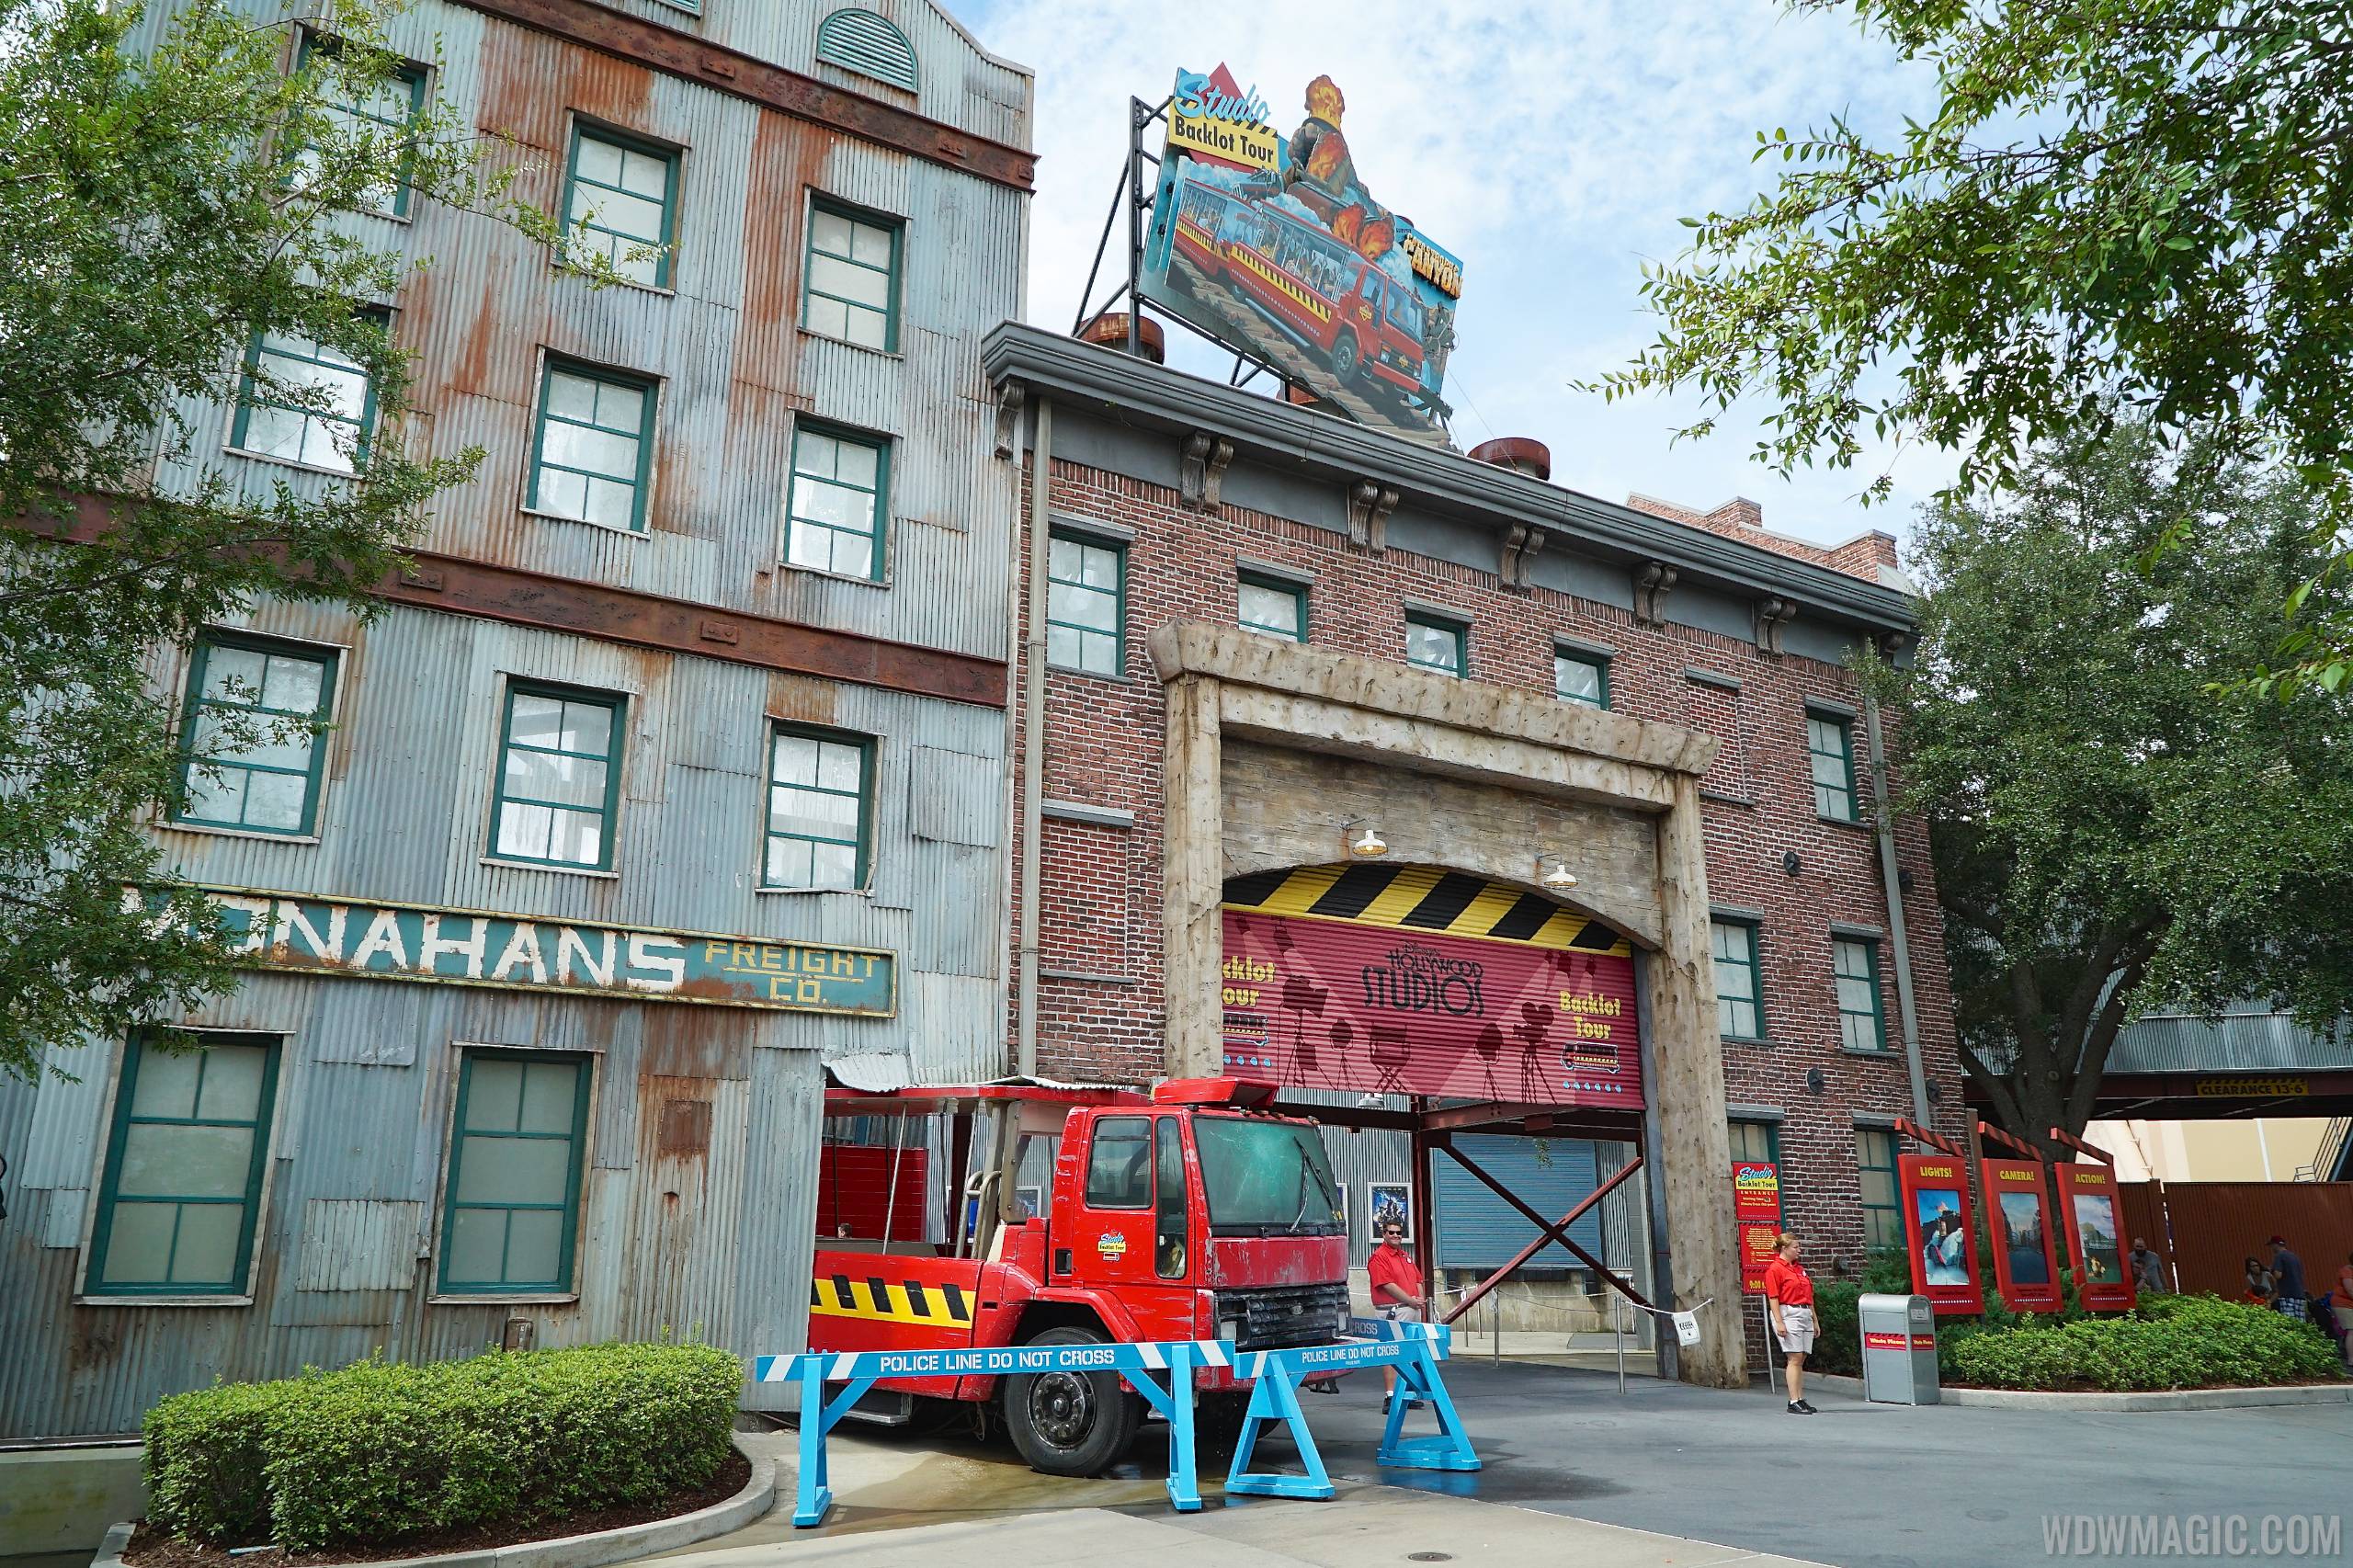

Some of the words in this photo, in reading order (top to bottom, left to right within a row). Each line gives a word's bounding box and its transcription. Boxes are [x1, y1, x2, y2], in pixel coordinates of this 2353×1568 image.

[1174, 74, 1271, 123] Studio
[1175, 115, 1234, 152] Backlot
[1240, 135, 1273, 163] Tour
[1404, 240, 1463, 299] CANYON
[704, 939, 881, 978] FREIGHT
[1222, 955, 1276, 983] cklot
[1385, 948, 1484, 978] HOLLYWOOD
[769, 977, 827, 1004] CO.
[1222, 987, 1260, 1007] our
[1362, 965, 1485, 1018] STUDIOS
[1560, 991, 1621, 1017] Backlot
[1573, 1016, 1611, 1040] Tour
[2201, 1085, 2272, 1096] CLEARANCE
[1739, 1165, 1773, 1181] Studio
[1919, 1166, 1953, 1178] LIGHTS!
[1999, 1170, 2035, 1181] CAMERA!
[2075, 1174, 2106, 1185] ACTION!
[1354, 1322, 1378, 1335] ROSS
[880, 1355, 938, 1372] POLICE
[945, 1353, 982, 1370] LINE
[988, 1352, 1012, 1369] DO
[1018, 1351, 1053, 1368] NOT
[1059, 1348, 1115, 1367] CROSS
[1302, 1350, 1328, 1363] POLICE
[1329, 1348, 1347, 1360] LINE
[1347, 1347, 1358, 1359] DO
[1360, 1346, 1375, 1358] NOT
[1377, 1345, 1400, 1357] CROSS
